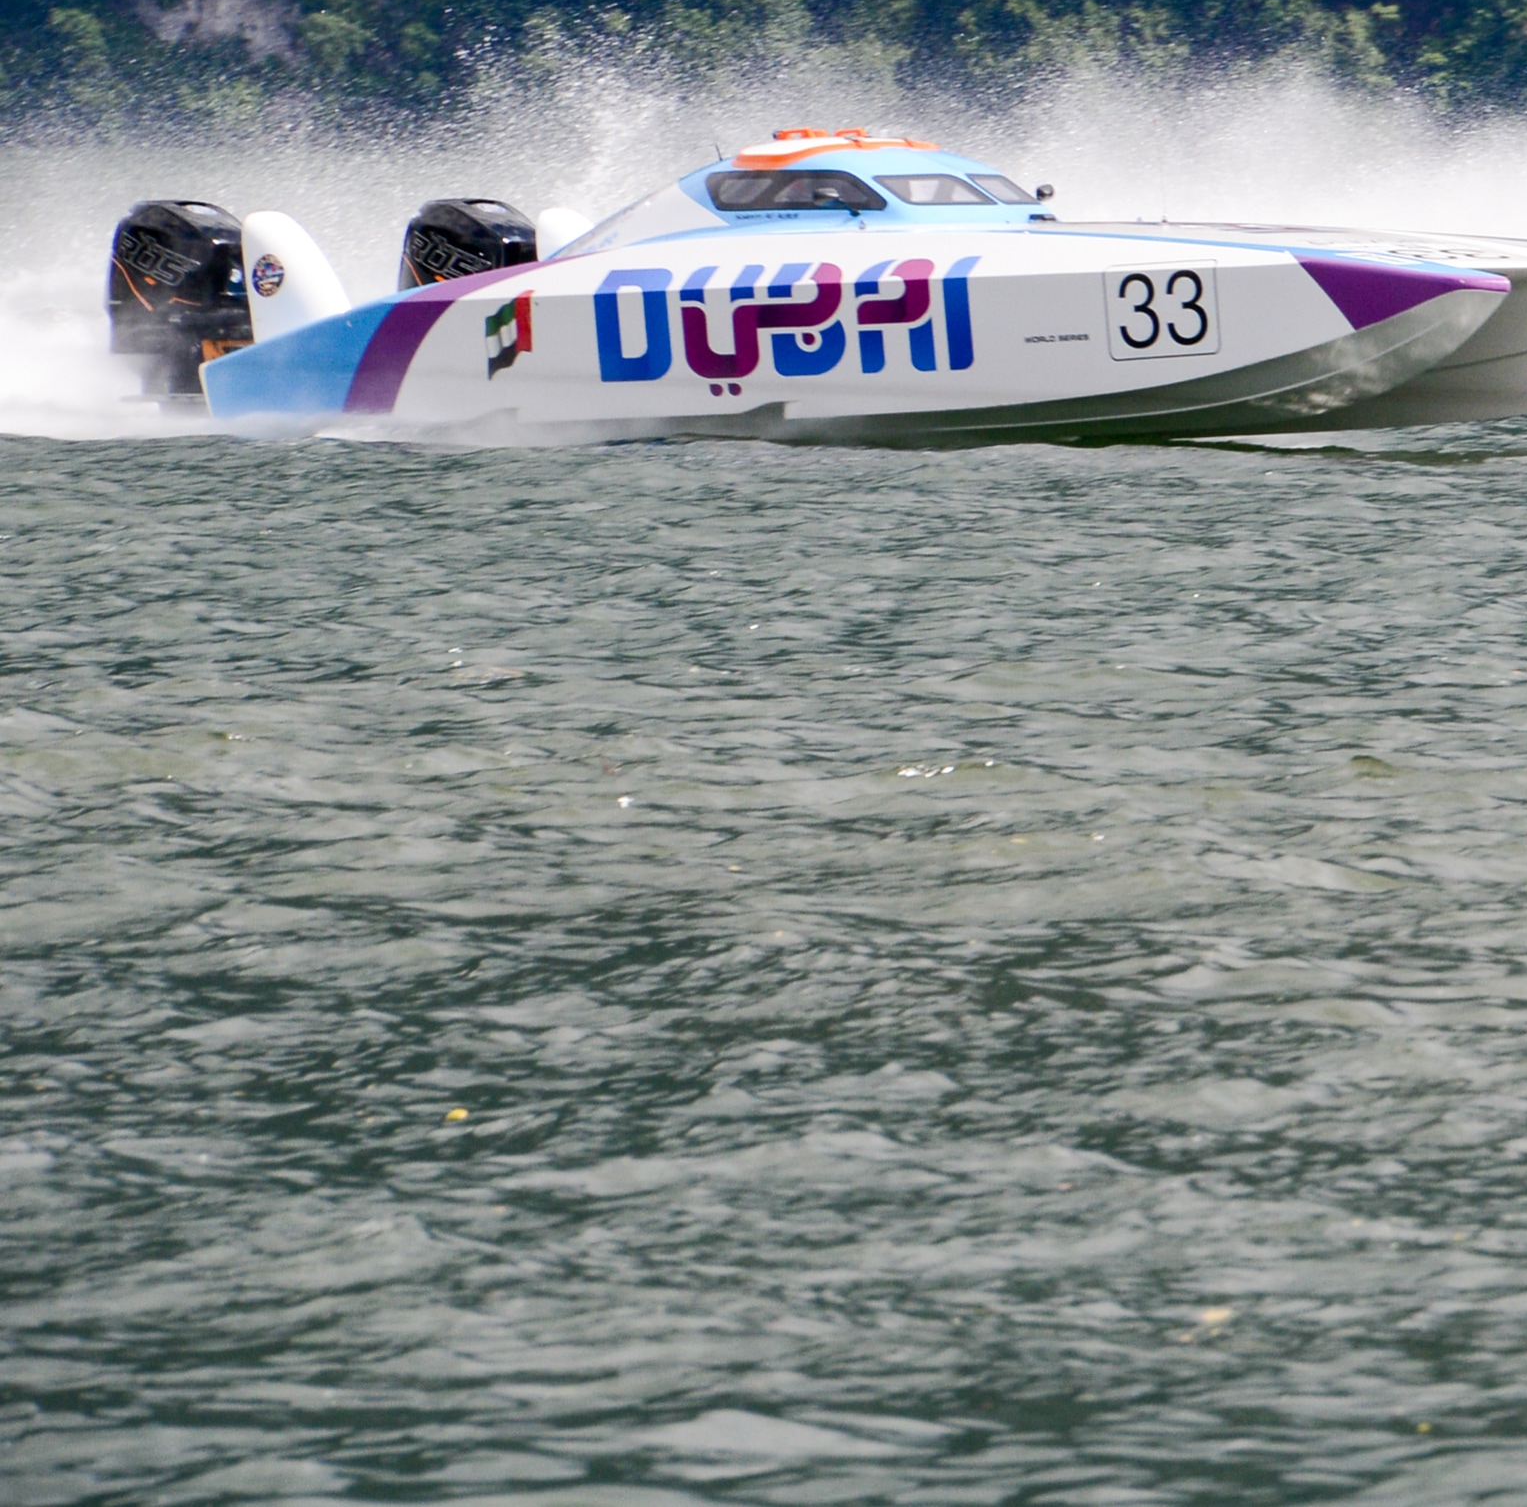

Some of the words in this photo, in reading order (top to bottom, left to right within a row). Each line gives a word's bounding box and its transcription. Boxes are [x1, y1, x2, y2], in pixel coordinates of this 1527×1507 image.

[593, 256, 982, 383] DUBAI
[1024, 335, 1056, 343] WORLD
[1058, 333, 1089, 342] SERIES
[1118, 269, 1209, 349] 33
